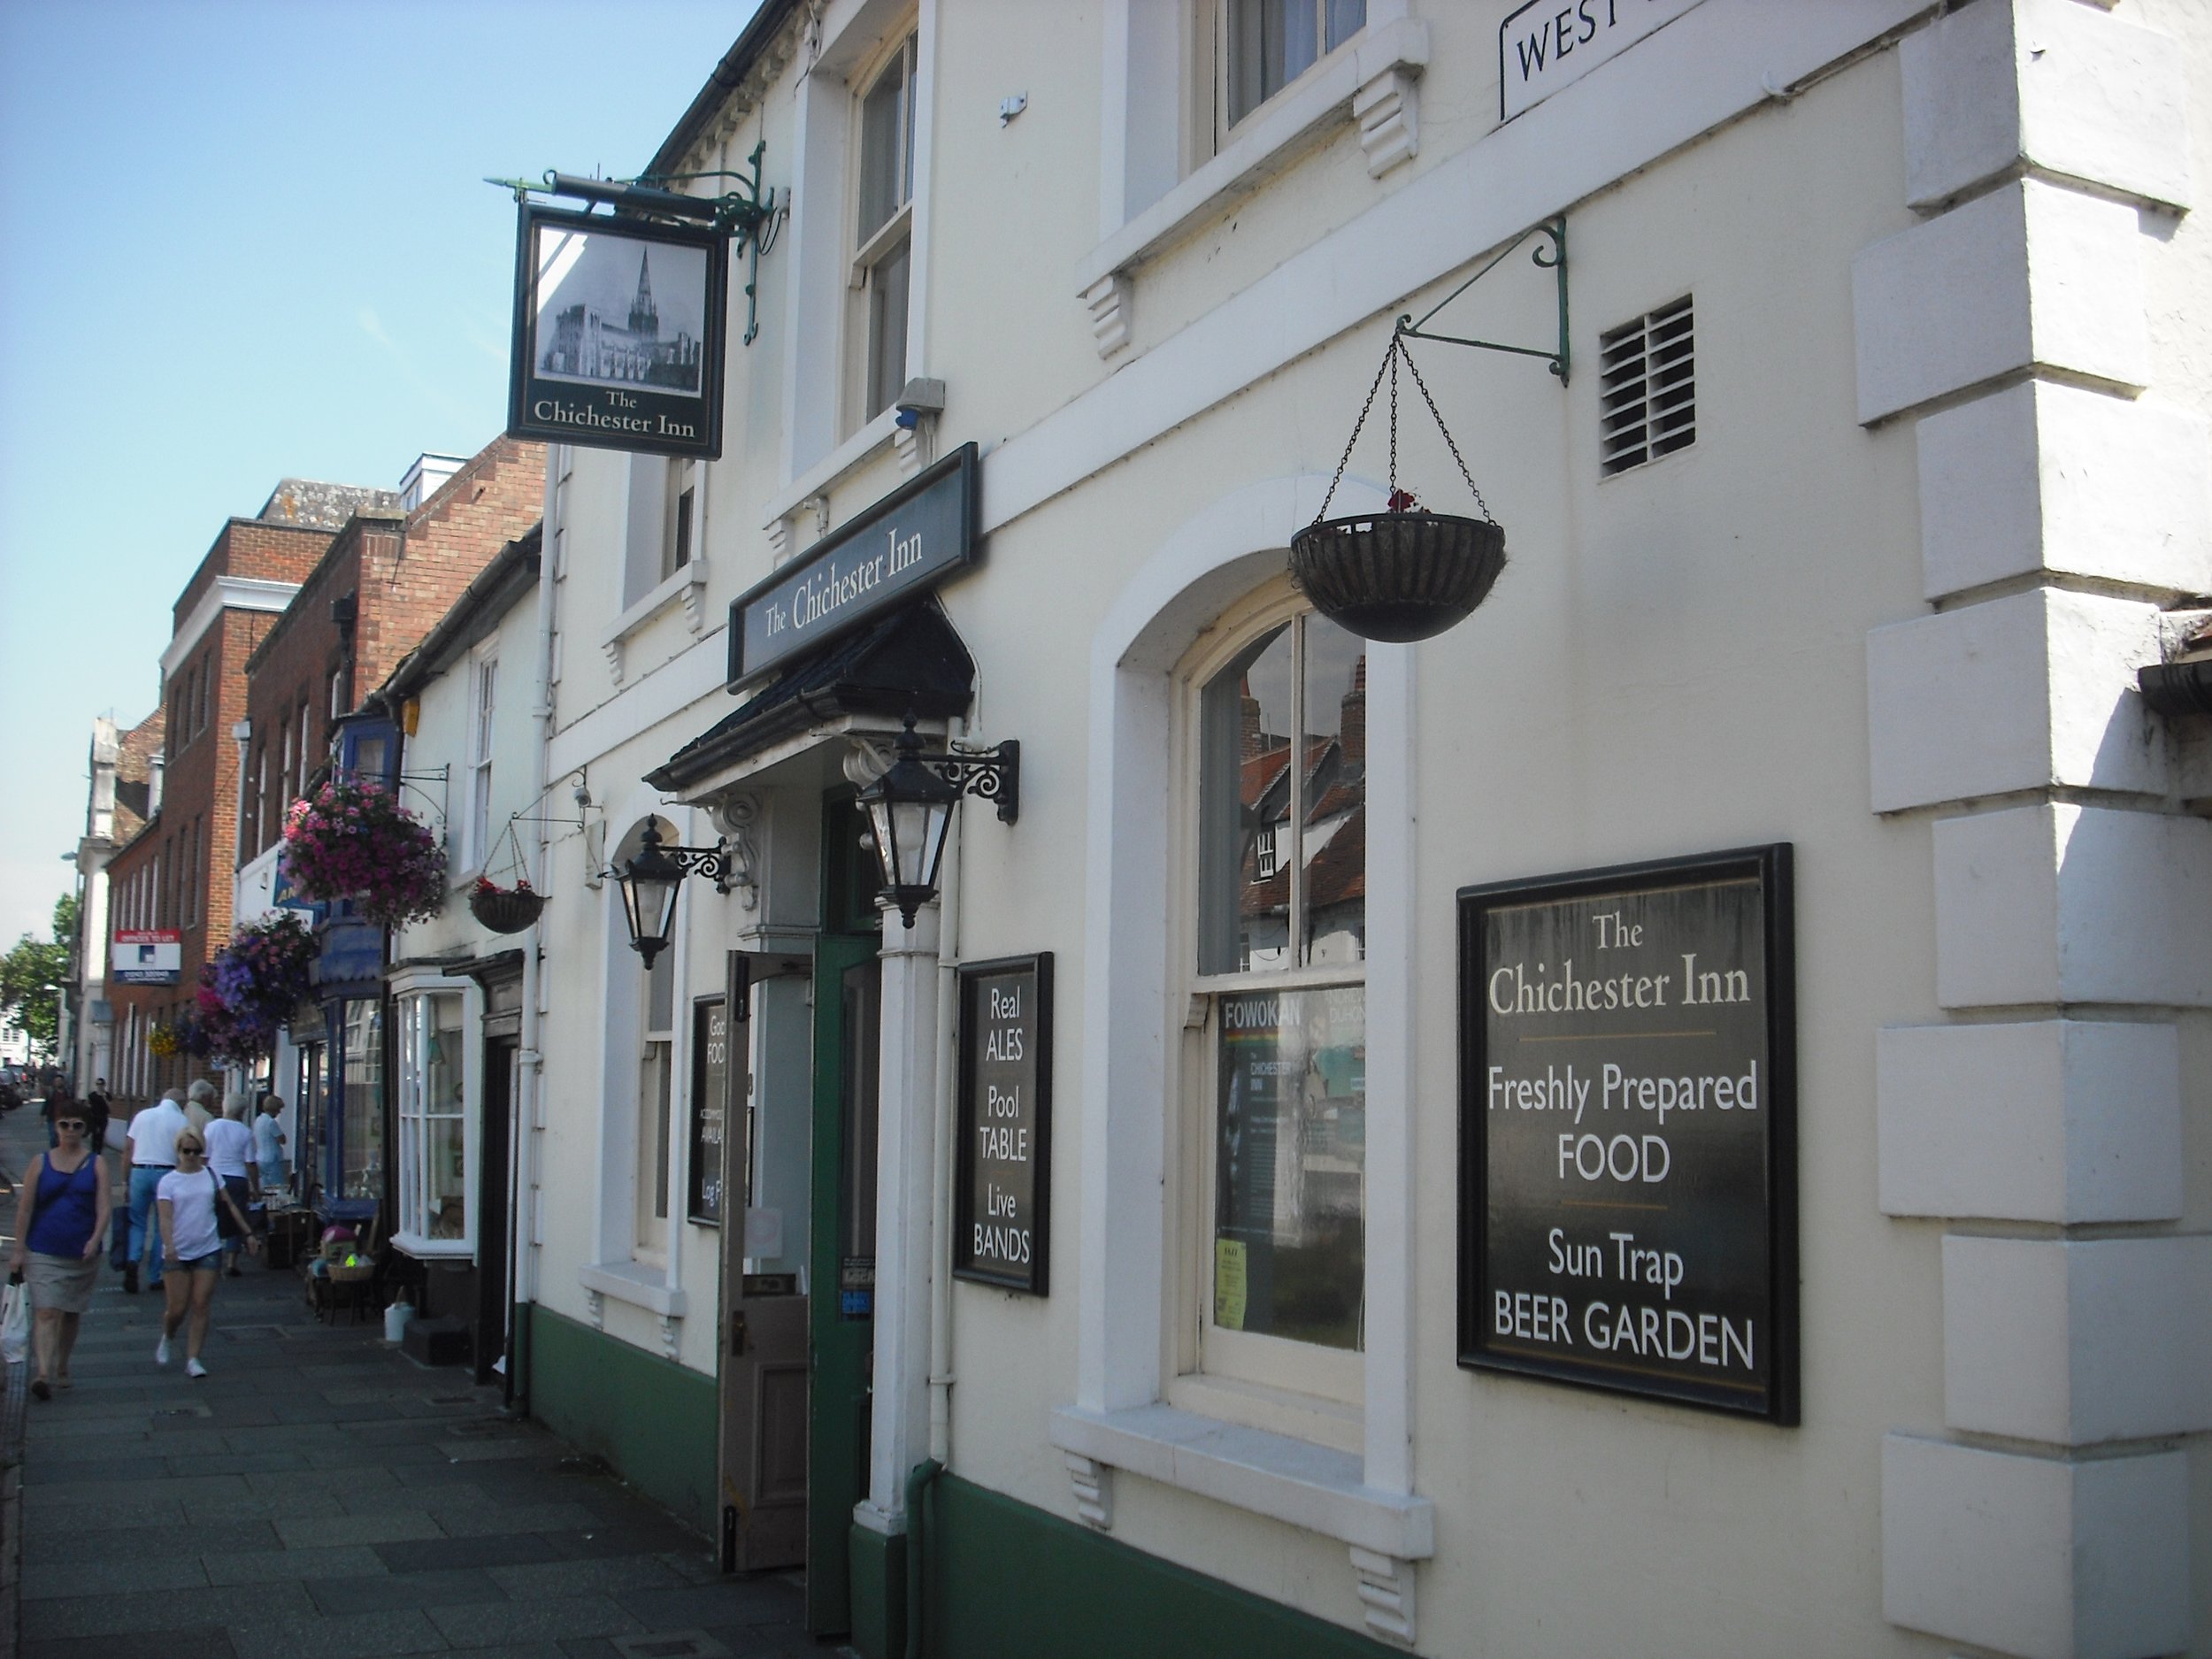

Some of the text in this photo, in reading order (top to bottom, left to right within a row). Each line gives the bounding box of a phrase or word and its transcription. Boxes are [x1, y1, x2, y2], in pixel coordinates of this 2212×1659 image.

[606, 390, 637, 409] The
[534, 400, 695, 438] Chichester Inn
[765, 527, 923, 637] The Chichester Inn
[1593, 910, 1643, 949] The
[1489, 953, 1751, 1014] Chichester Inn
[991, 986, 1020, 1020] Real
[1225, 999, 1301, 1029] FOWOKAN
[710, 1015, 725, 1037] Goo
[707, 1042, 724, 1064] FOO
[986, 1027, 1023, 1062] ALES
[988, 1085, 1019, 1118] Pool
[1488, 1059, 1757, 1125] Freshly Prepared
[979, 1126, 1027, 1162] TABLE
[1559, 1134, 1671, 1183] FOOD
[702, 1179, 715, 1207] Log
[987, 1183, 1017, 1218] Live
[973, 1224, 1030, 1263] BANDS
[1548, 1227, 1684, 1300] Sun Trap
[1495, 1290, 1754, 1370] BEER GARDEN
